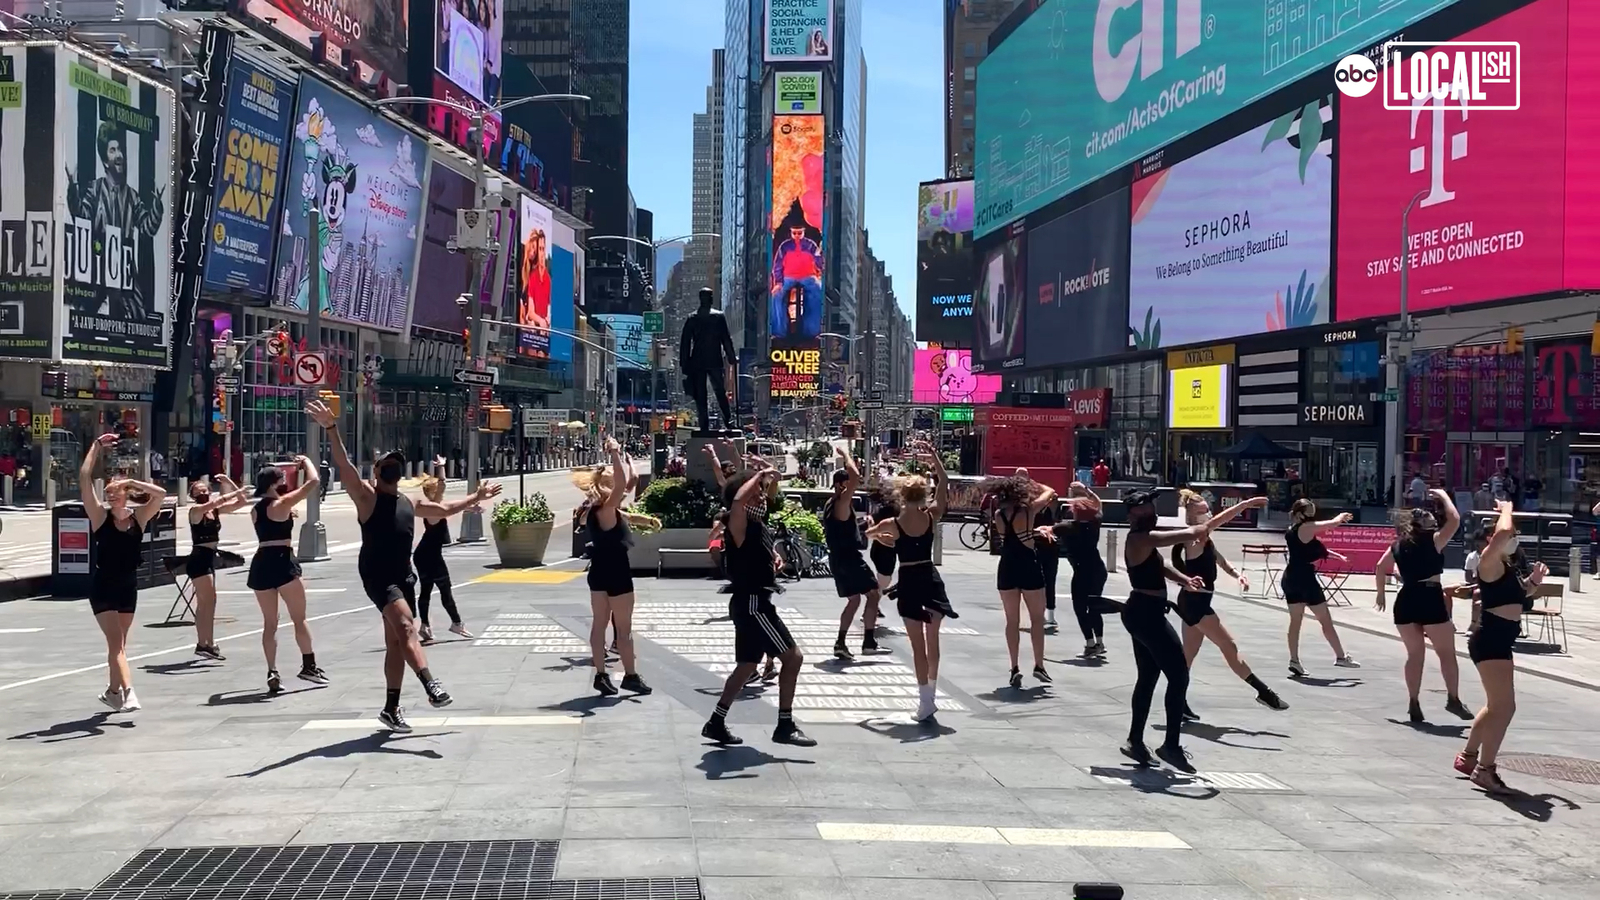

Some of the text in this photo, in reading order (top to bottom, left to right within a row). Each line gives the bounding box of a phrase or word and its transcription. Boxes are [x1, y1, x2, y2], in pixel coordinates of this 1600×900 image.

[27, 14, 72, 26] LAMAR
[772, 9, 805, 17] SOCIAL
[302, 9, 351, 45] REALTY TRUST
[772, 18, 826, 26] DISTANCING
[771, 28, 804, 36] & HELP
[771, 38, 795, 46] SAVE
[1364, 33, 1405, 58] MARROTT
[106, 102, 115, 119] ON
[1085, 63, 1226, 159] cit.com/ActsOfCaring
[230, 117, 246, 131] COME
[247, 125, 274, 142] TOGETHER
[228, 128, 280, 169] COME
[367, 174, 408, 201] WELCOME
[219, 183, 274, 222] AWAY
[977, 199, 1013, 228] #CITCares
[1184, 210, 1251, 248] SEPHORA
[1441, 221, 1473, 244] OPEN
[1156, 230, 1289, 279] We Belong to Something Beautiful
[1367, 258, 1391, 278] STAY
[1420, 247, 1445, 267] AND
[1447, 230, 1524, 262] CONNECTED
[1, 282, 15, 292] The
[932, 295, 972, 305] NOW WE
[942, 307, 973, 317] ANYW
[79, 317, 126, 334] JAW-DROPPING
[1324, 330, 1356, 343] SEPHORA
[771, 350, 820, 362] OLIVER
[786, 362, 820, 374] TREE
[119, 392, 138, 401] SONY
[1304, 405, 1365, 421] SEPHORA
[473, 638, 579, 646] PALACE
